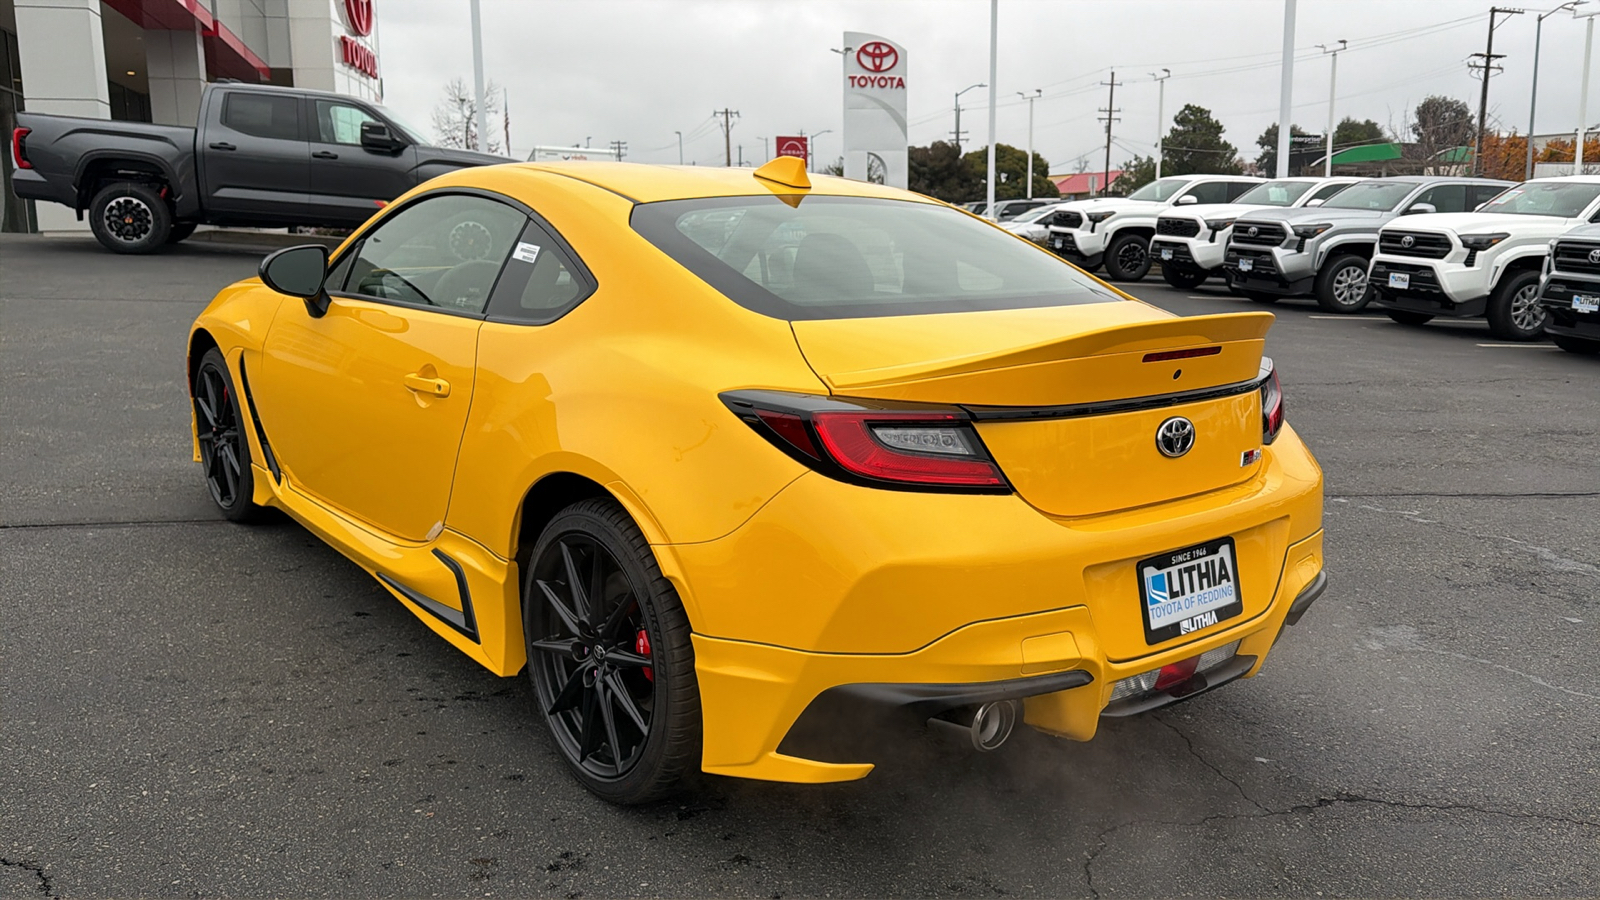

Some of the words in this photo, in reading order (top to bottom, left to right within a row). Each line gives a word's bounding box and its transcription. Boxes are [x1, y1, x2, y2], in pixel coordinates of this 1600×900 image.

[848, 75, 906, 89] TOYOTA
[1580, 298, 1599, 306] LITHIA
[1171, 551, 1191, 564] SINCE
[1192, 547, 1207, 558] 1946
[1166, 556, 1231, 600] LITHIA
[1150, 601, 1183, 620] TOYOTA
[1184, 596, 1196, 610] OF
[1197, 585, 1233, 607] REDDING
[1189, 610, 1218, 632] LITHIA
